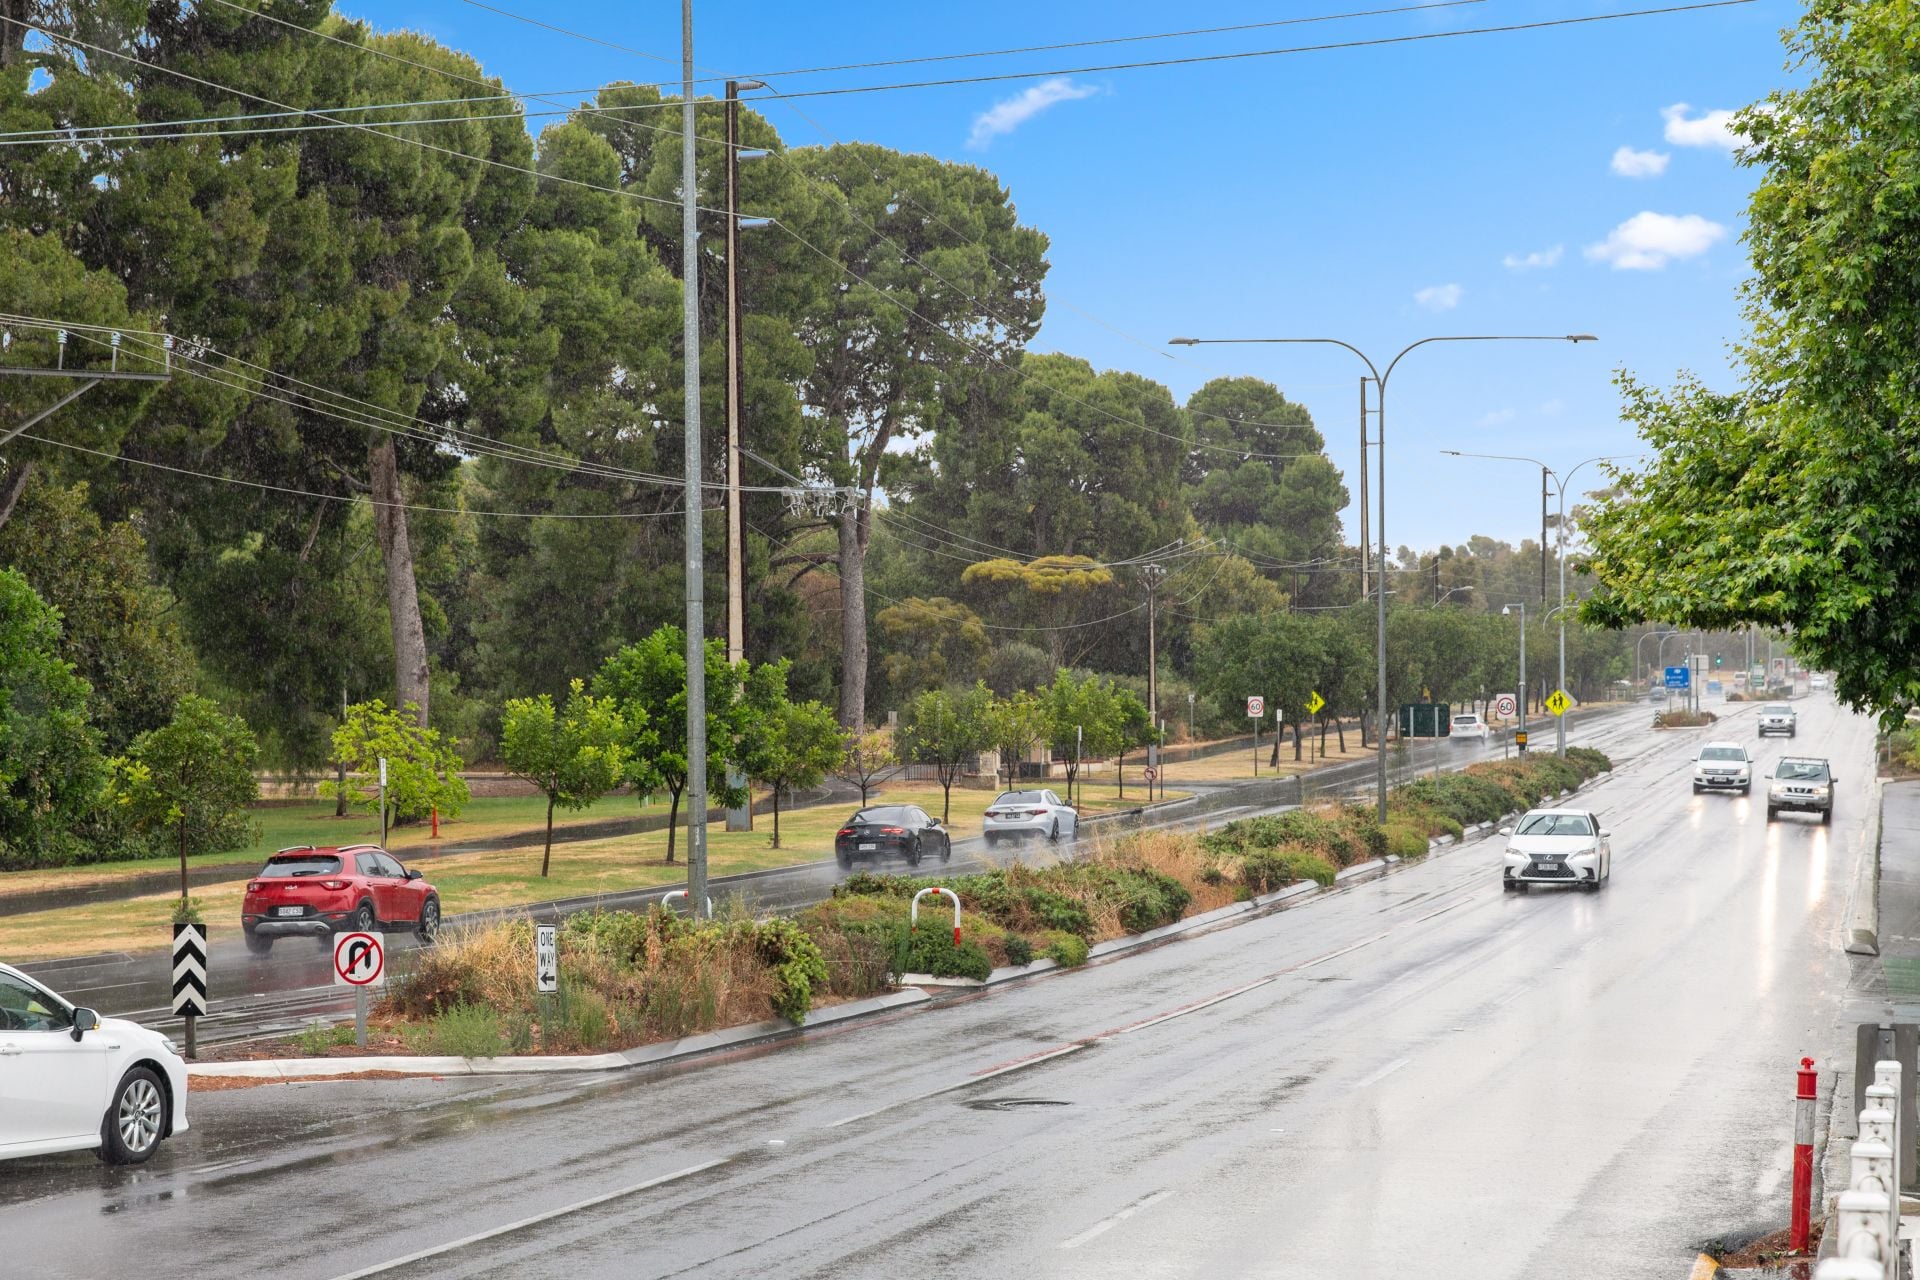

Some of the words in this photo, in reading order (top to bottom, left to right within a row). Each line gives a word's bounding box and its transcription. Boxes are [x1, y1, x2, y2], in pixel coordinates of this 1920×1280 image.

[1500, 701, 1512, 711] 60
[540, 931, 554, 947] ONE
[539, 952, 554, 968] WAY
